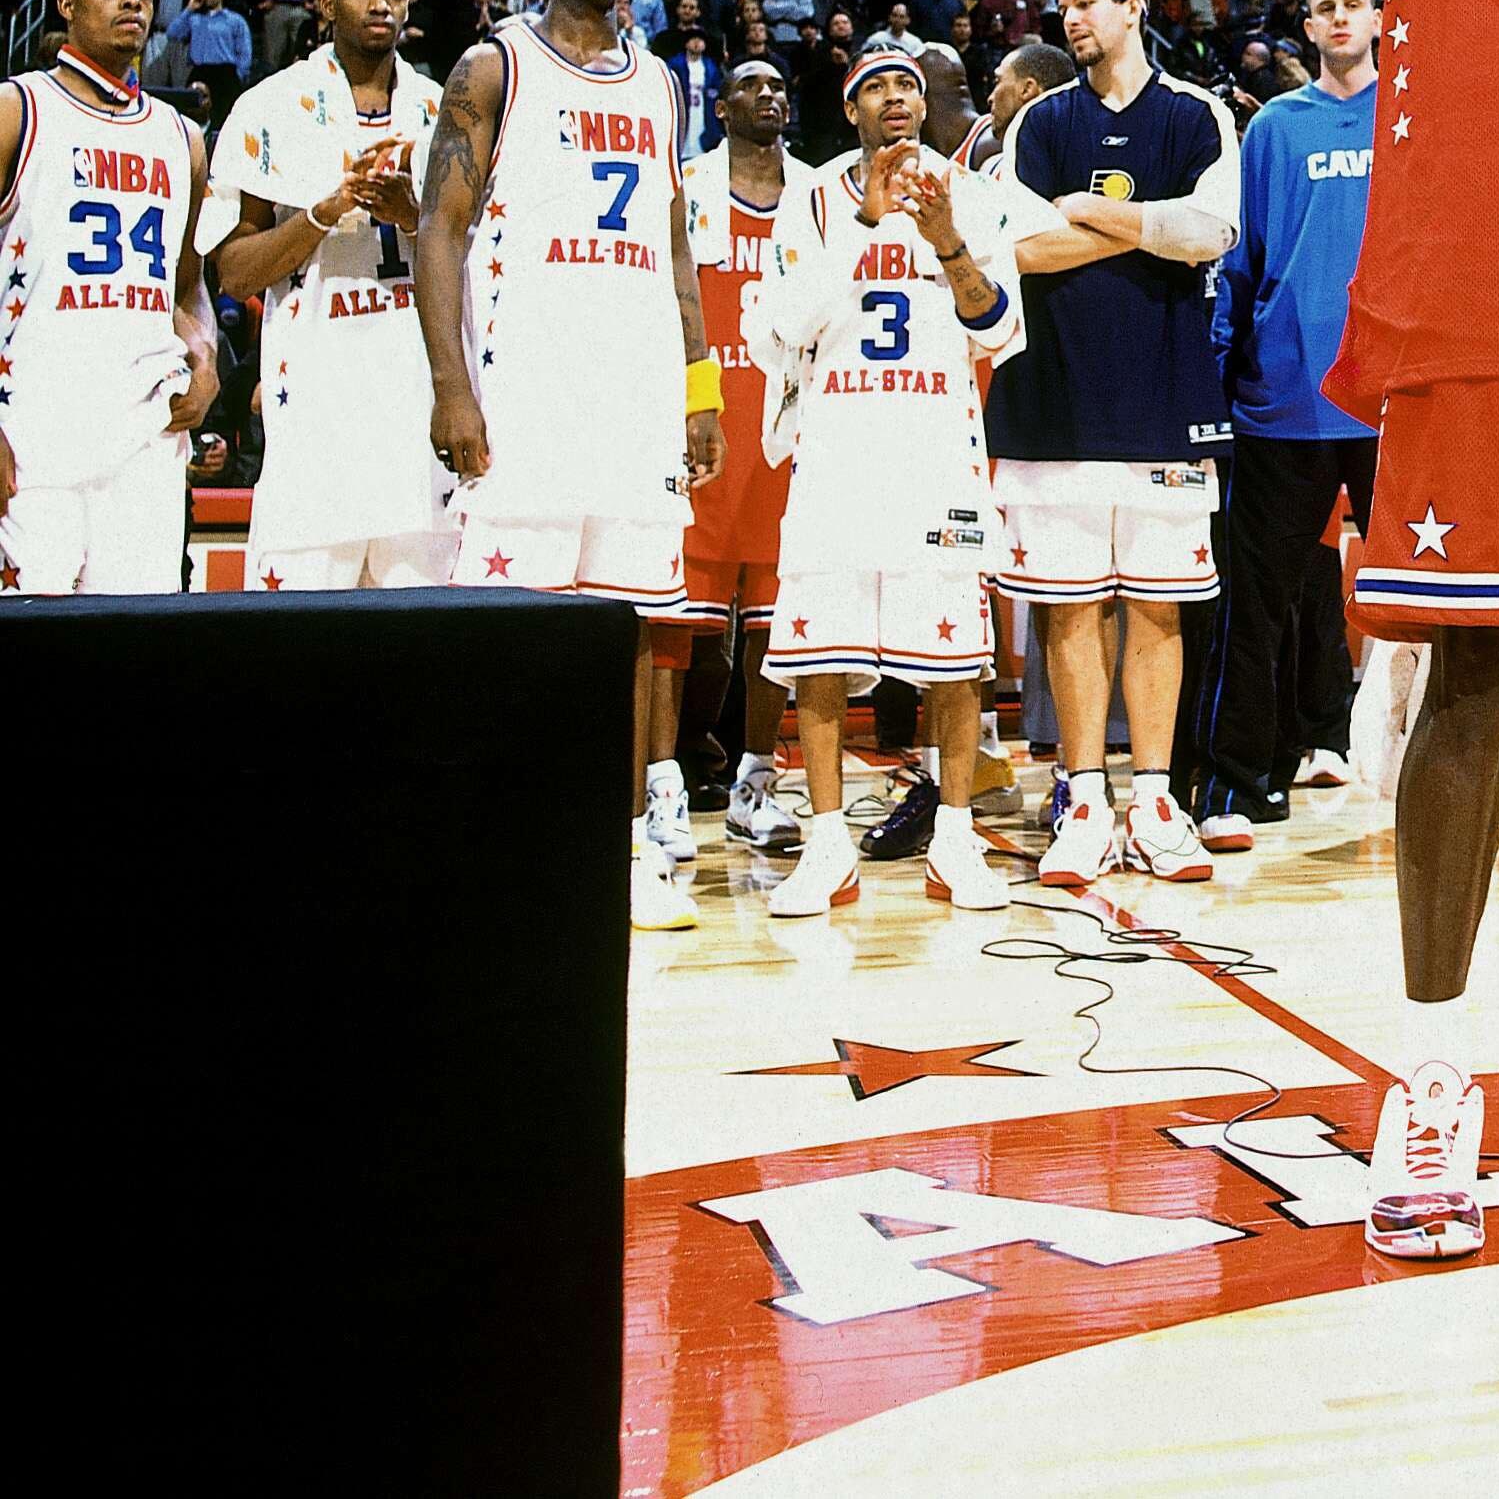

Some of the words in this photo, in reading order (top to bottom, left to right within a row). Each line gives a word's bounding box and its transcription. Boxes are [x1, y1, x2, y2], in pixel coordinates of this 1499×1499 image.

[579, 110, 657, 160] NBA
[93, 147, 172, 199] NBA
[591, 160, 641, 233] 7
[67, 199, 167, 281] 34
[545, 237, 657, 274] ALL-STA
[55, 283, 172, 314] ALL-STA
[860, 290, 911, 361] 3
[823, 369, 949, 395] ALL-STAR
